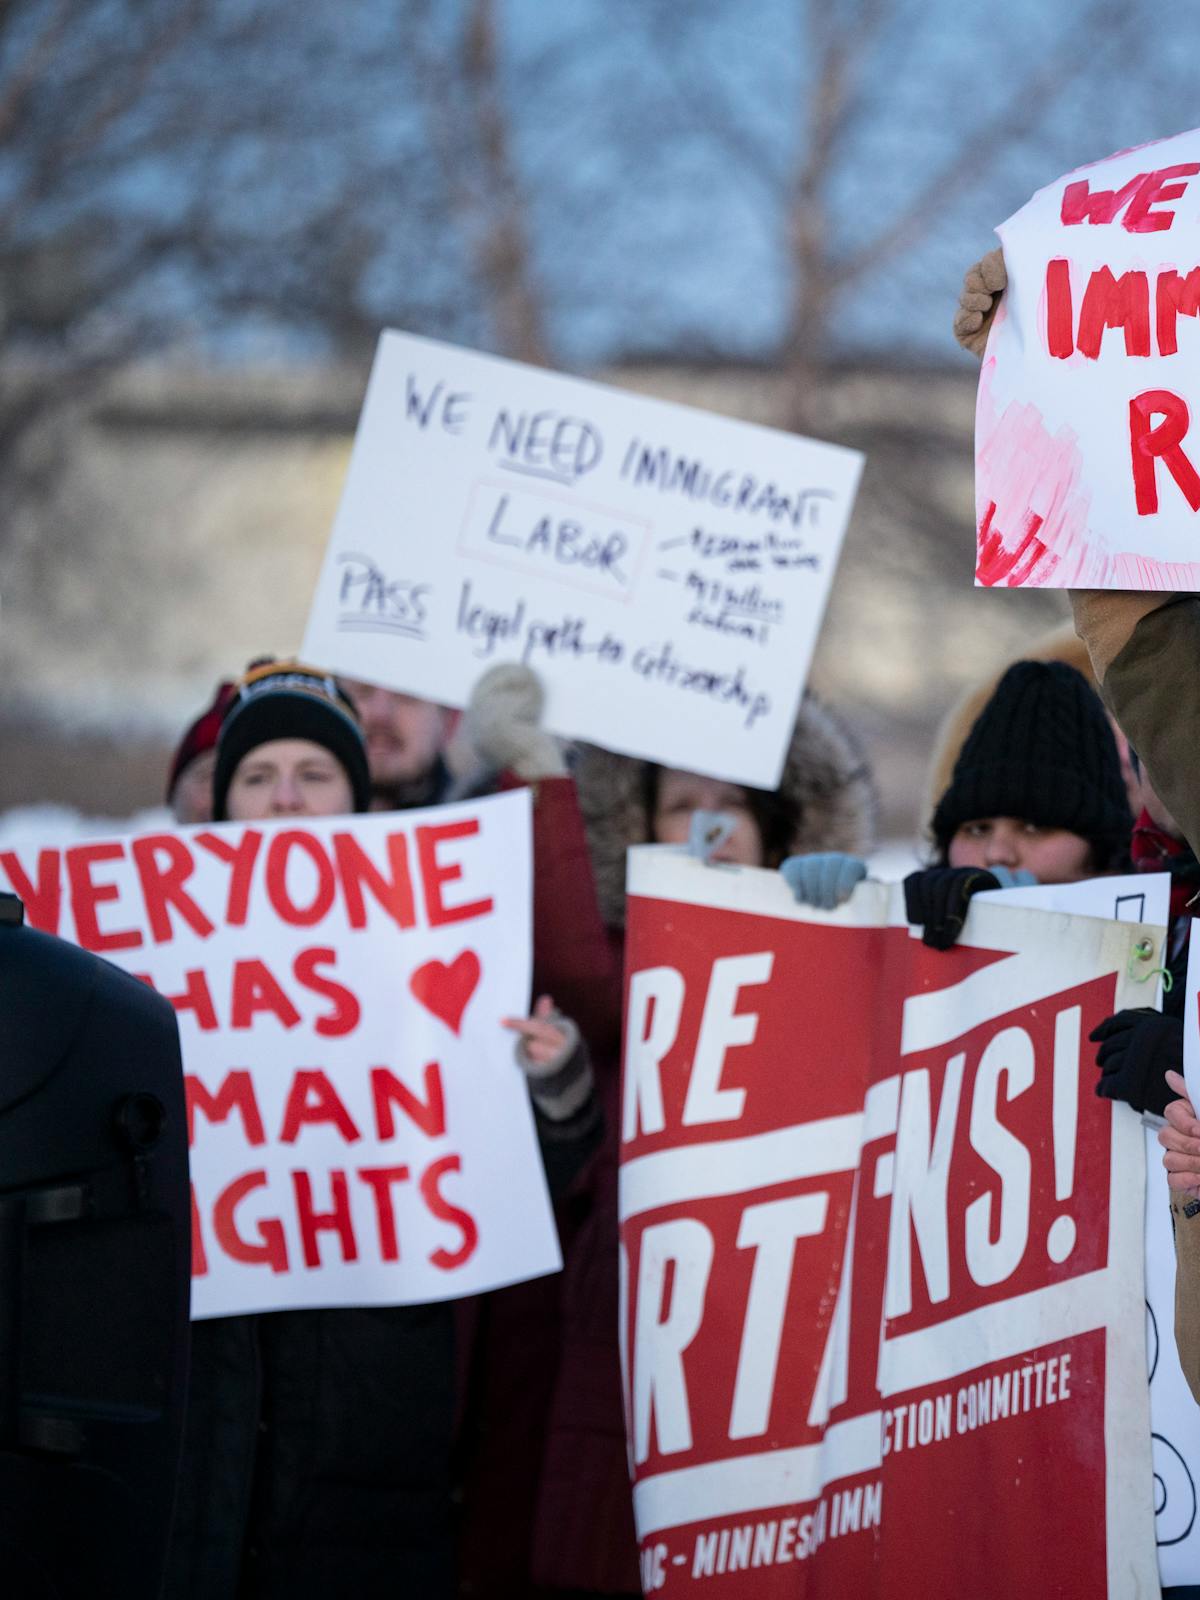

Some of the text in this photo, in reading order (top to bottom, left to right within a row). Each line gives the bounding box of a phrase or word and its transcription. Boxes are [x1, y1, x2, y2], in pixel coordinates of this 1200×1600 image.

[405, 374, 835, 526] WE NEED IMMIGRANT
[487, 494, 628, 586] LABOR
[336, 552, 430, 625] PASS
[0, 818, 494, 951] VERYONE
[956, 1353, 1071, 1434] COMMITTEE
